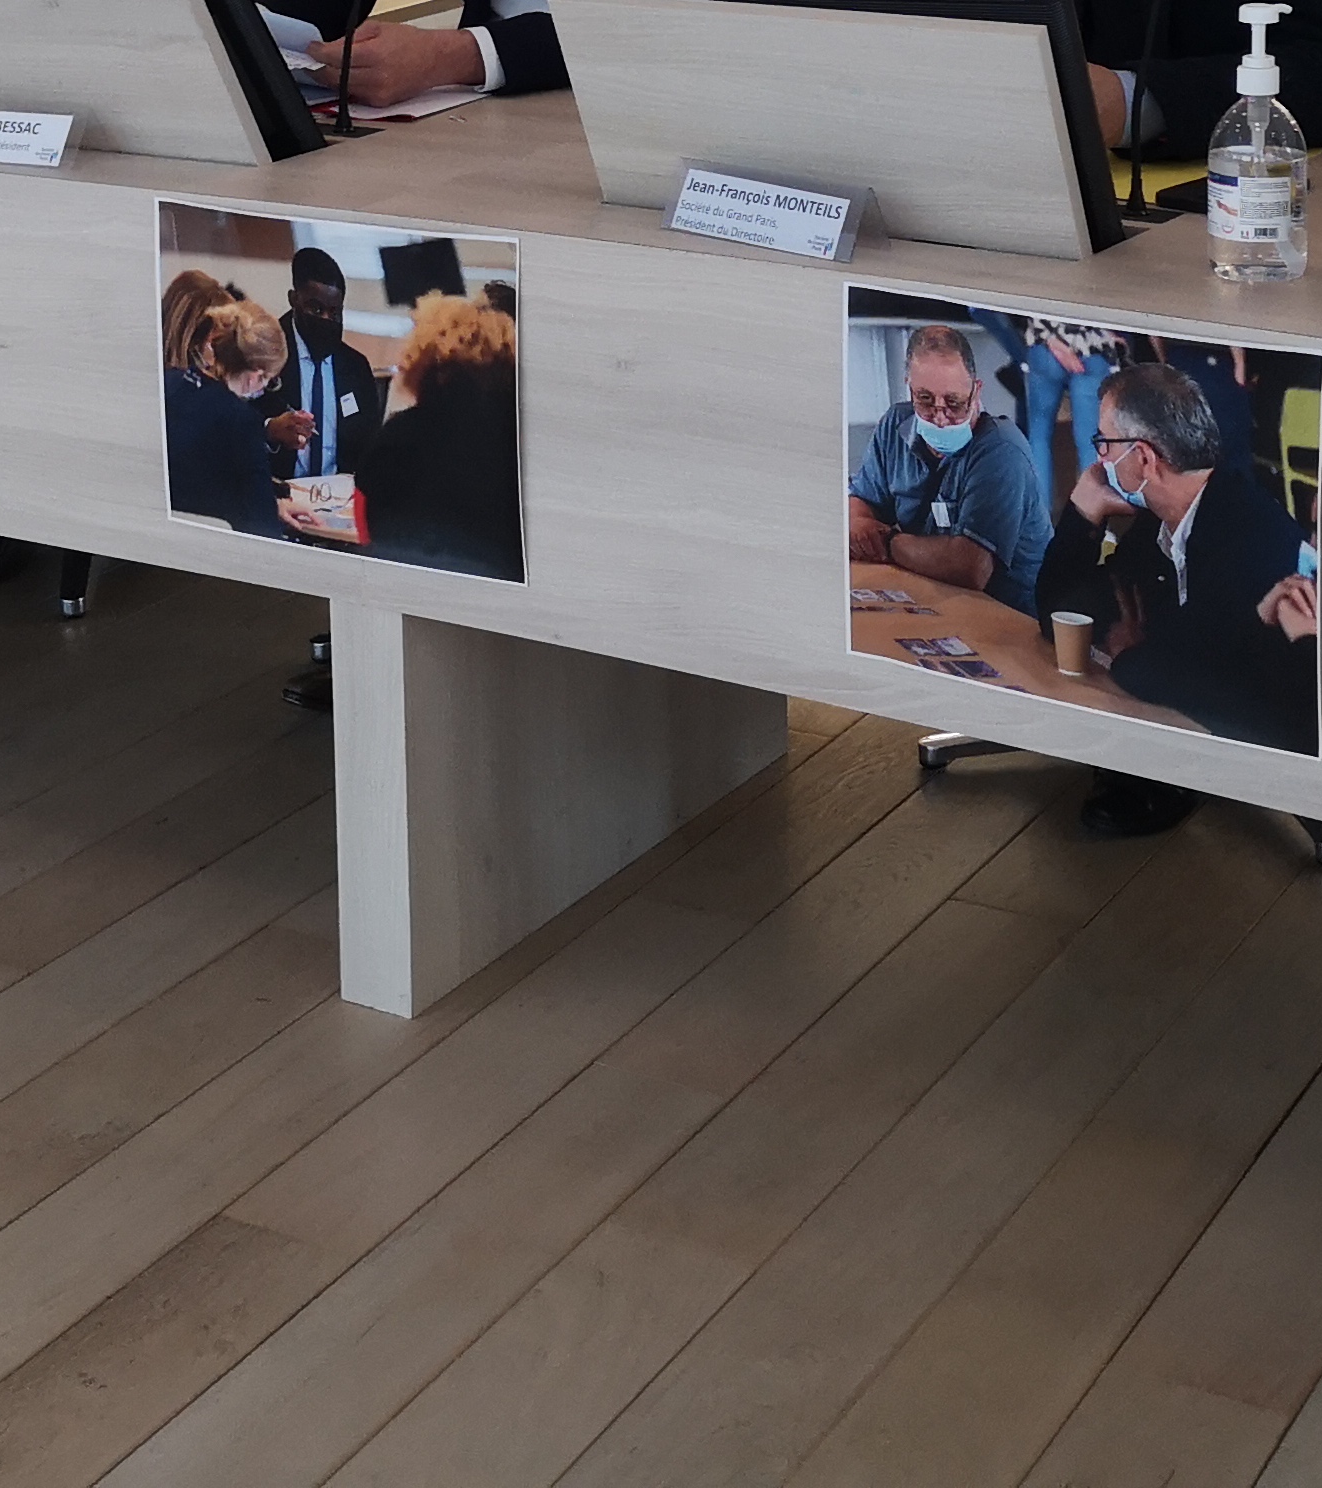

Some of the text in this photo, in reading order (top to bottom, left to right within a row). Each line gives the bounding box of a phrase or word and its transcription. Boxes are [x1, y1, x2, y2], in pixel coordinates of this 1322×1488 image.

[680, 198, 779, 229] Société du Grand Paris,
[686, 177, 844, 220] Jean-François MONTEILS
[675, 215, 775, 246] Président du Directoire
